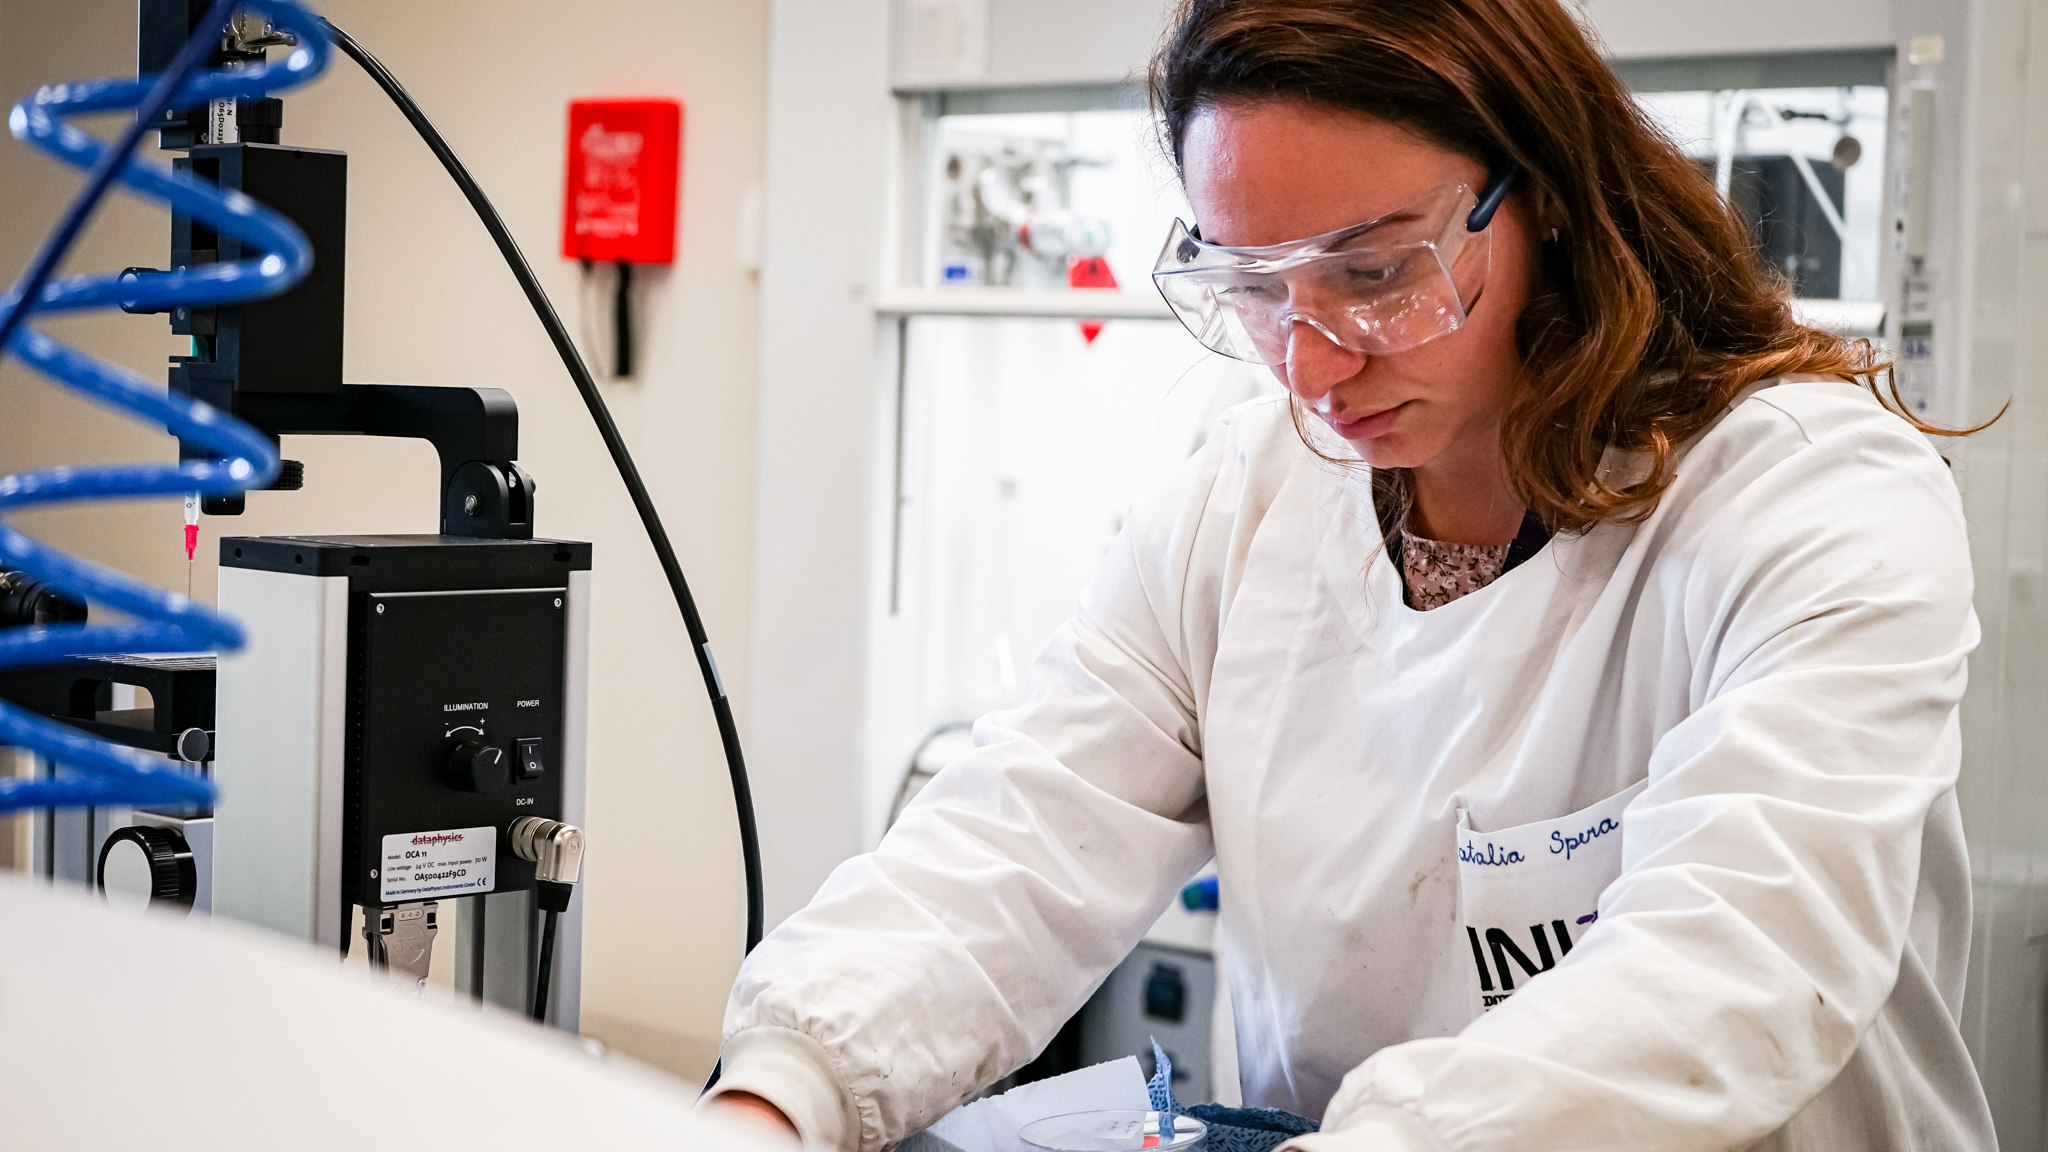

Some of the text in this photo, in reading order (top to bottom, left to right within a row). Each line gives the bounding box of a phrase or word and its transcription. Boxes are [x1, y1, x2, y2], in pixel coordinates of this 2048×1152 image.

[444, 702, 489, 712] ILLUMINATION
[516, 700, 540, 708] POWER
[516, 798, 534, 806] DC-IN
[411, 832, 463, 847] dataphysics
[1459, 817, 1619, 866] atalia Spera
[405, 850, 420, 859] OCA
